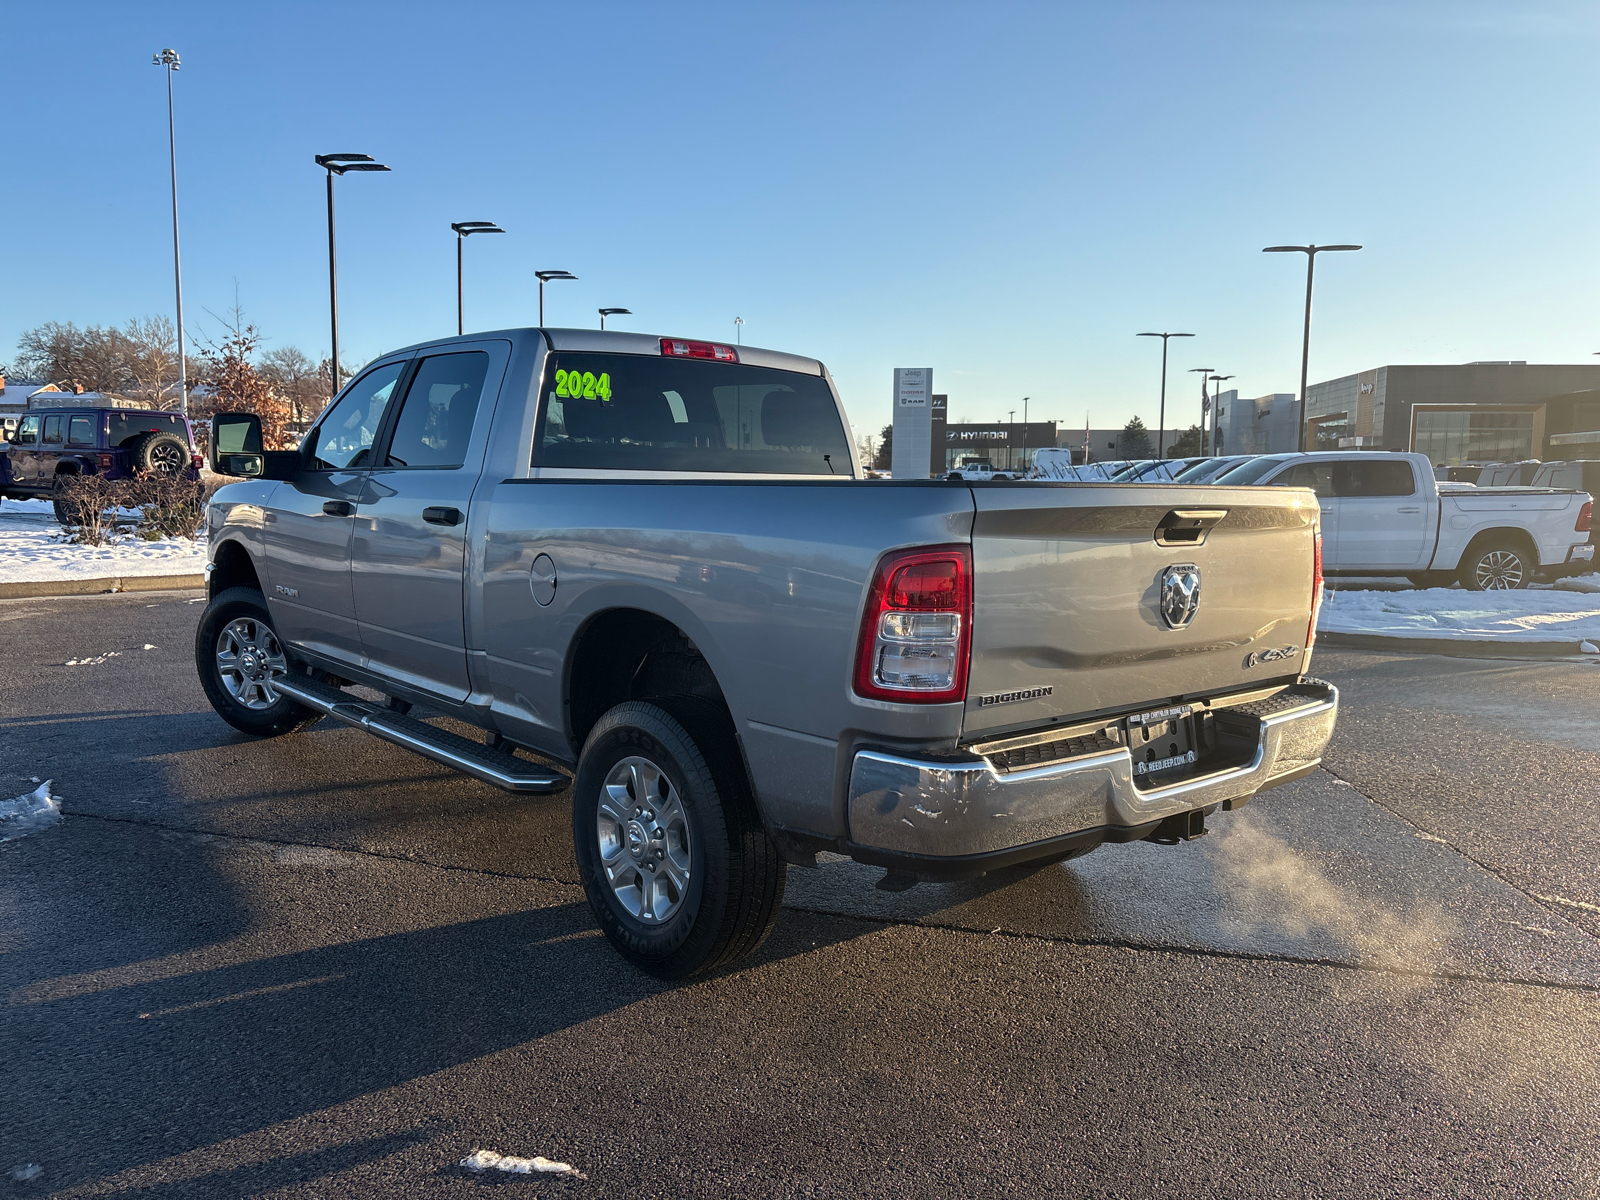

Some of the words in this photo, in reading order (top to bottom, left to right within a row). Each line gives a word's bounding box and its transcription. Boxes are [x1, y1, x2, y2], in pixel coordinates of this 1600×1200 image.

[555, 369, 612, 401] 2024
[961, 431, 1008, 440] HYUNDAI
[275, 584, 299, 598] RAM
[981, 685, 1054, 706] BIGHORN
